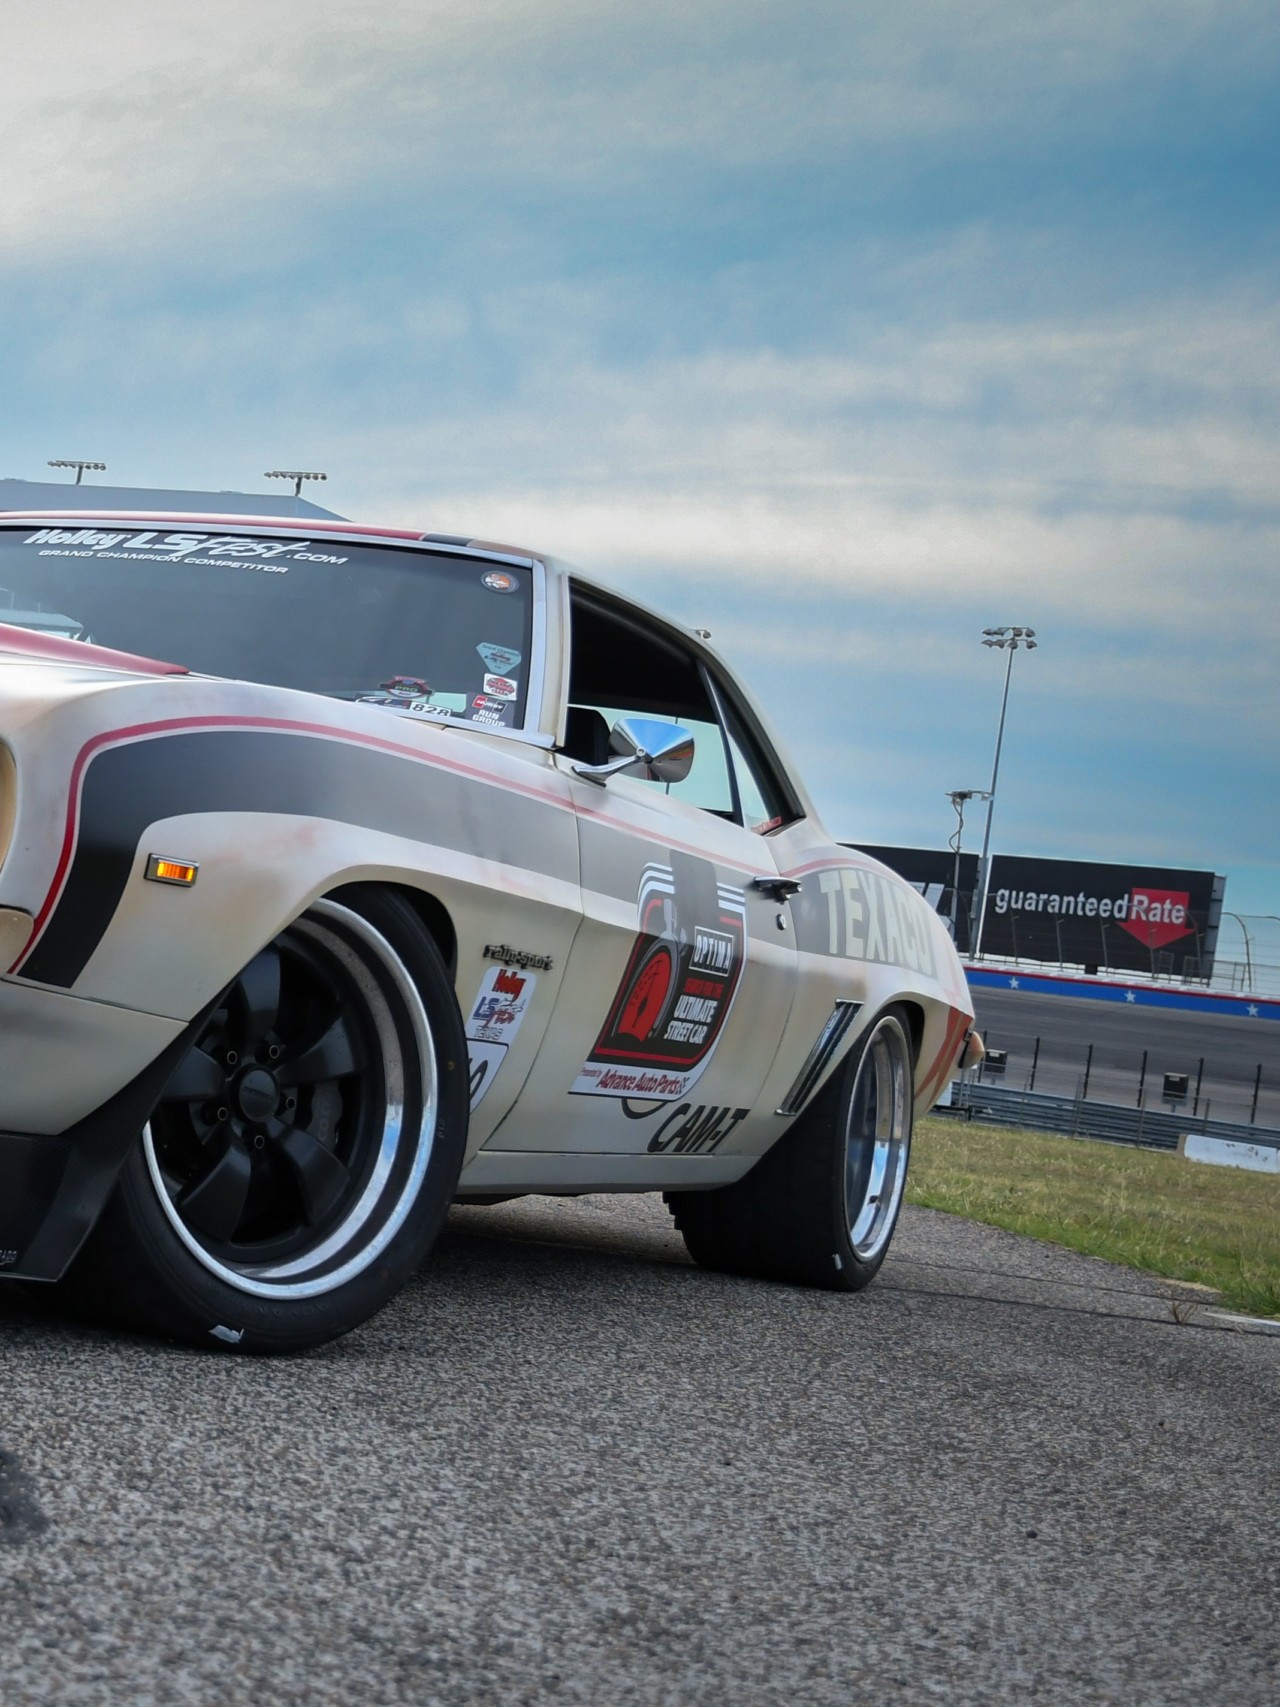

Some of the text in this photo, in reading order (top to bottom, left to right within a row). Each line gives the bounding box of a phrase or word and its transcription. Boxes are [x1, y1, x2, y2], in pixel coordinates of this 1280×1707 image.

[23, 529, 124, 550] Holley
[38, 550, 289, 574] GRAND CHAMPION COMPETITOR
[472, 714, 505, 727] GROUP
[478, 709, 500, 719] RUN
[819, 869, 934, 976] TEXACO
[693, 935, 732, 969] OPTIMA
[673, 994, 719, 1023] ULTIMATE
[663, 1020, 708, 1044] STREET CAR
[596, 1069, 637, 1091] Advance
[633, 1072, 657, 1093] Auto
[654, 1074, 681, 1095] Parts
[646, 1102, 751, 1153] CAM-T
